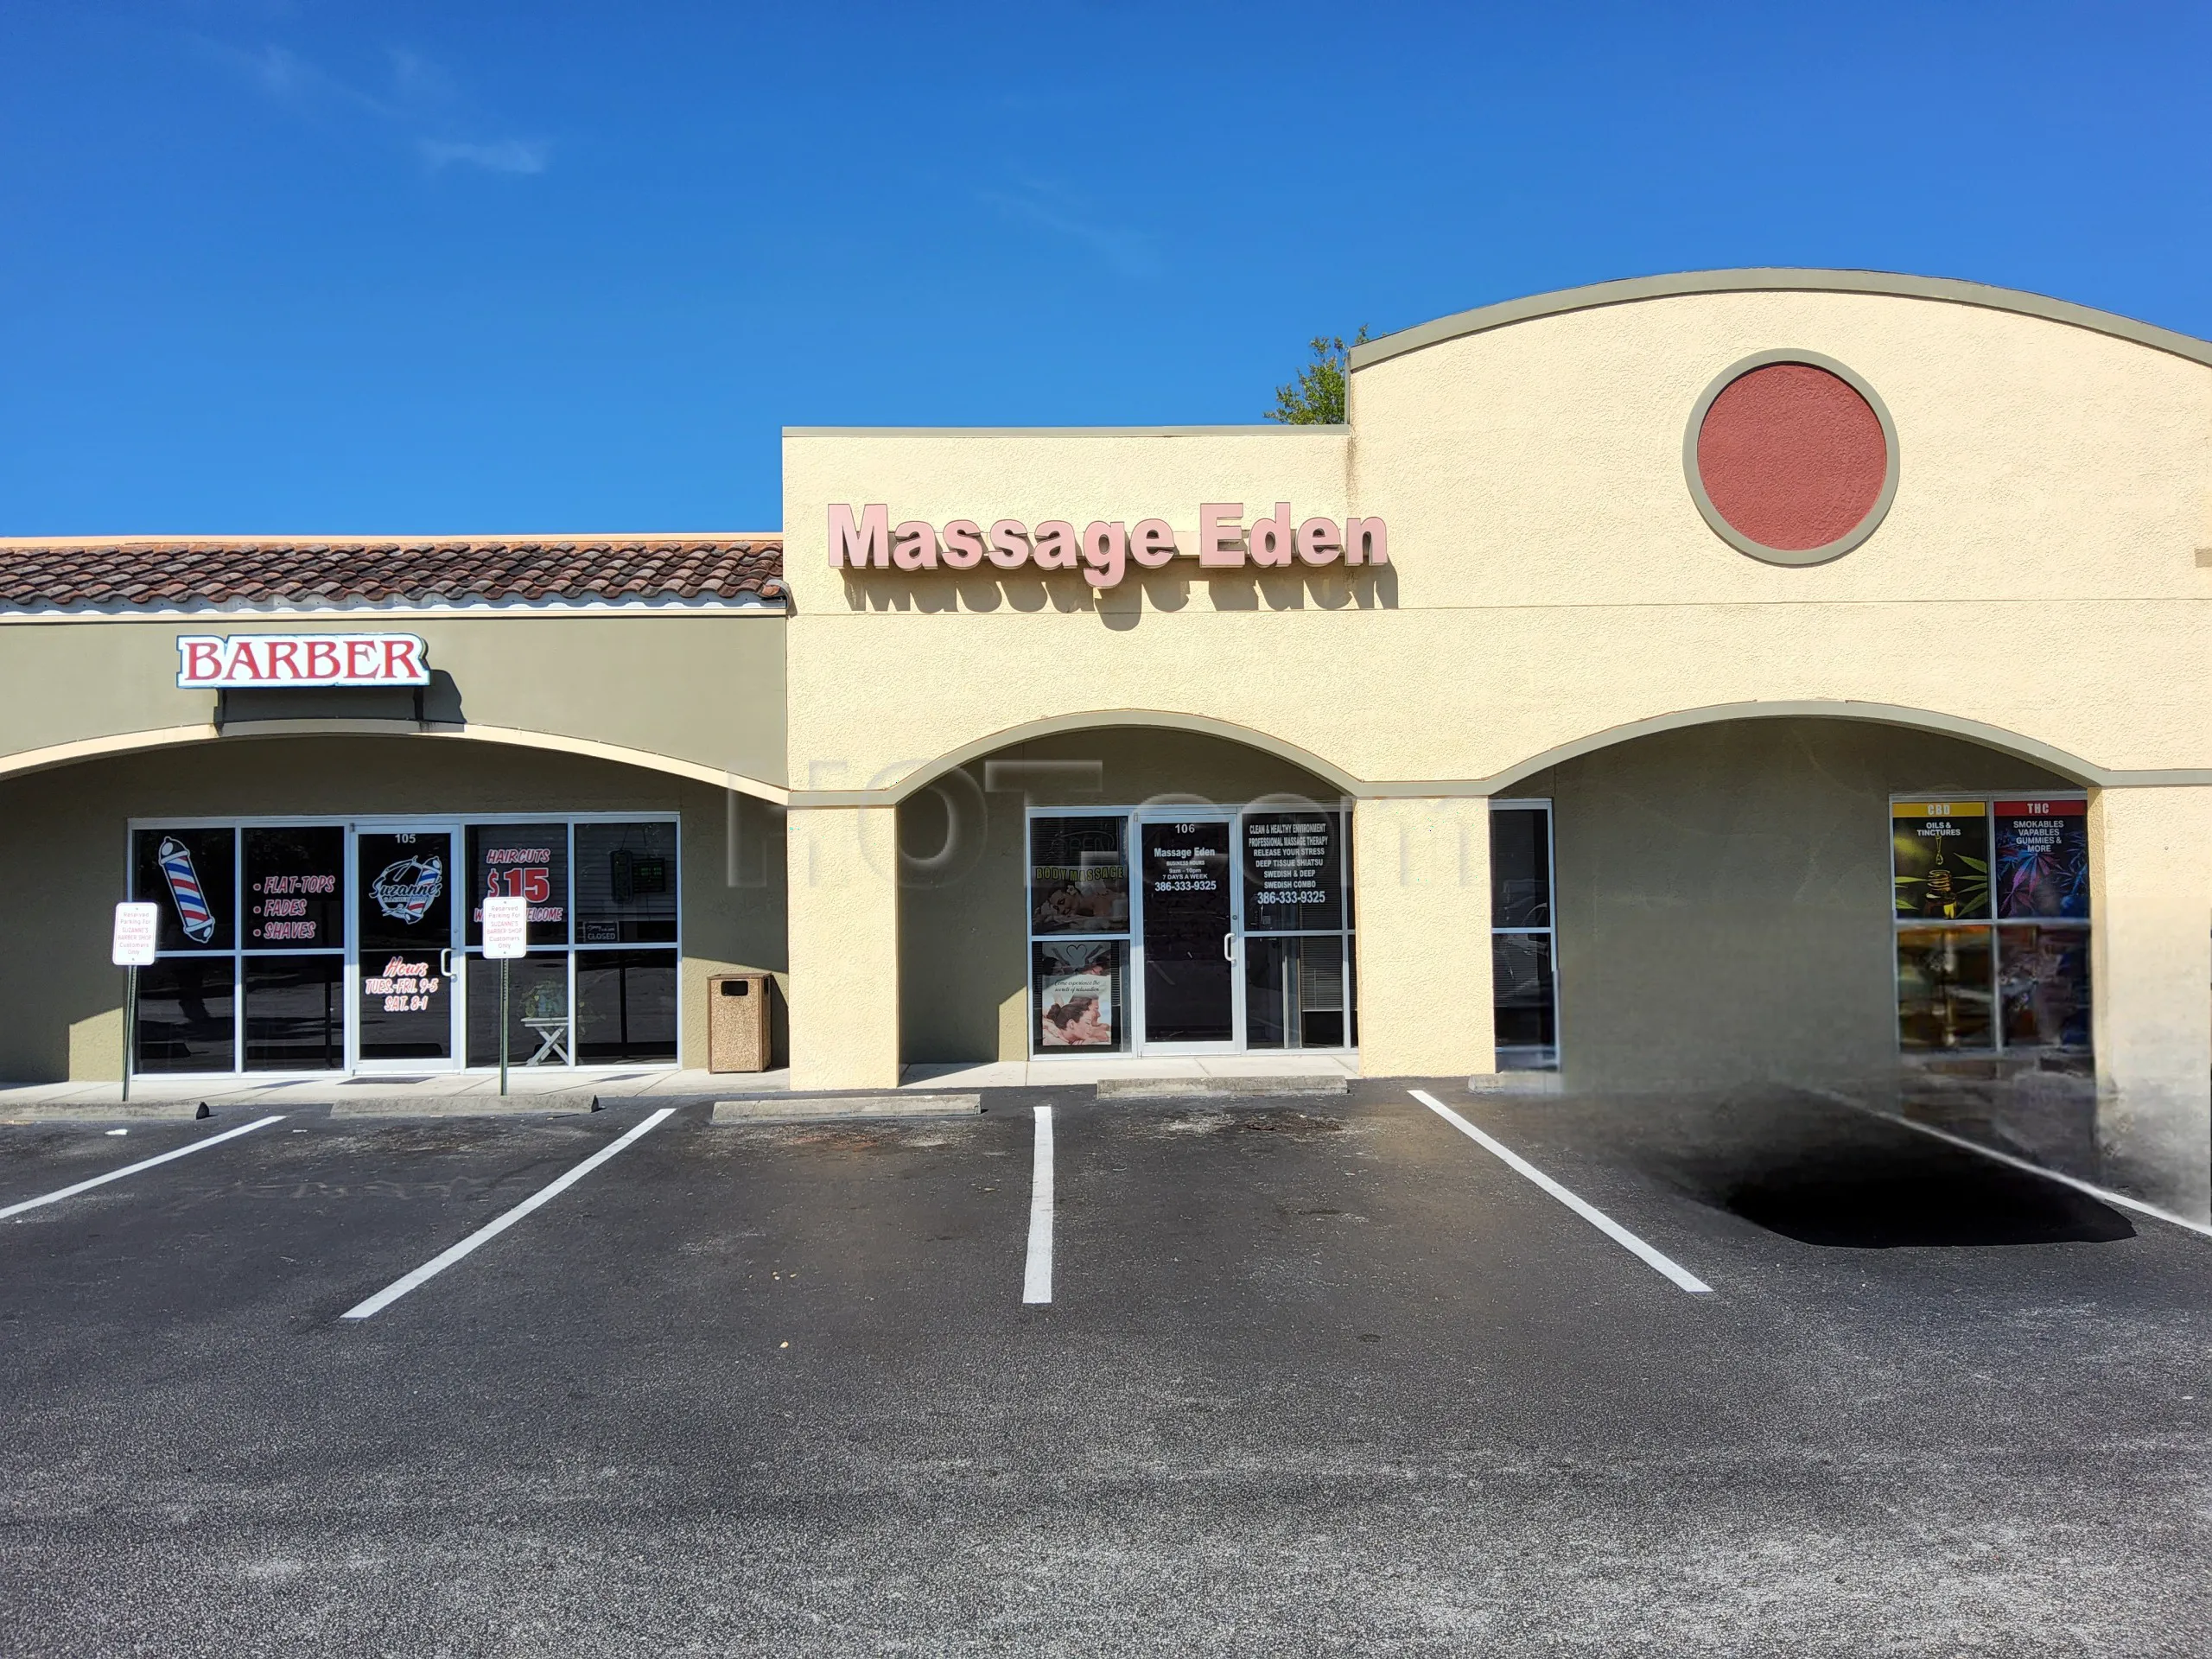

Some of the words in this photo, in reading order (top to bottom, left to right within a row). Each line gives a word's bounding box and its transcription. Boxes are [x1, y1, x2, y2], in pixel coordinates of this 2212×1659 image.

[827, 503, 1174, 588] Massage
[1199, 502, 1388, 567] Eden
[184, 639, 422, 681] BARBER
[1928, 804, 1950, 816] CBD
[2027, 802, 2050, 815] THC
[1175, 823, 1195, 834] 106
[1249, 824, 1265, 835] CLEAN
[1266, 824, 1270, 834] &
[1270, 823, 1292, 834] HEALTHY
[1293, 823, 1326, 833] ENVIRONMENT
[2013, 820, 2064, 829] SMOKABLES
[395, 834, 416, 843] 105
[1249, 837, 1283, 847] PROFESSIONAL
[1283, 836, 1306, 846] MASSAGE
[1306, 836, 1328, 846] THERAPY
[1154, 848, 1192, 859] Massage
[1194, 847, 1215, 856] Eden
[1282, 848, 1300, 856] YOUR
[2027, 844, 2051, 853] MORE
[486, 849, 550, 863] HAIRCUTS
[1255, 859, 1272, 868] DEEP
[1296, 858, 1324, 867] SHIATSU
[1035, 867, 1066, 880] BODY
[1069, 866, 1123, 881] MASSAGE
[264, 875, 335, 893] FLAT-TOPS
[1154, 880, 1217, 891] 386-333-9325
[1264, 880, 1292, 889] SWEDISH
[1294, 880, 1316, 888] COMBO
[1257, 891, 1325, 905] 386-333-9325
[264, 899, 307, 917] FADES
[526, 907, 563, 922] ELCOME
[264, 921, 316, 939] SHAVES
[383, 956, 429, 977] Hours
[419, 977, 439, 994] 9-5
[384, 995, 410, 1012] SAT.
[410, 995, 429, 1011] 8-1
